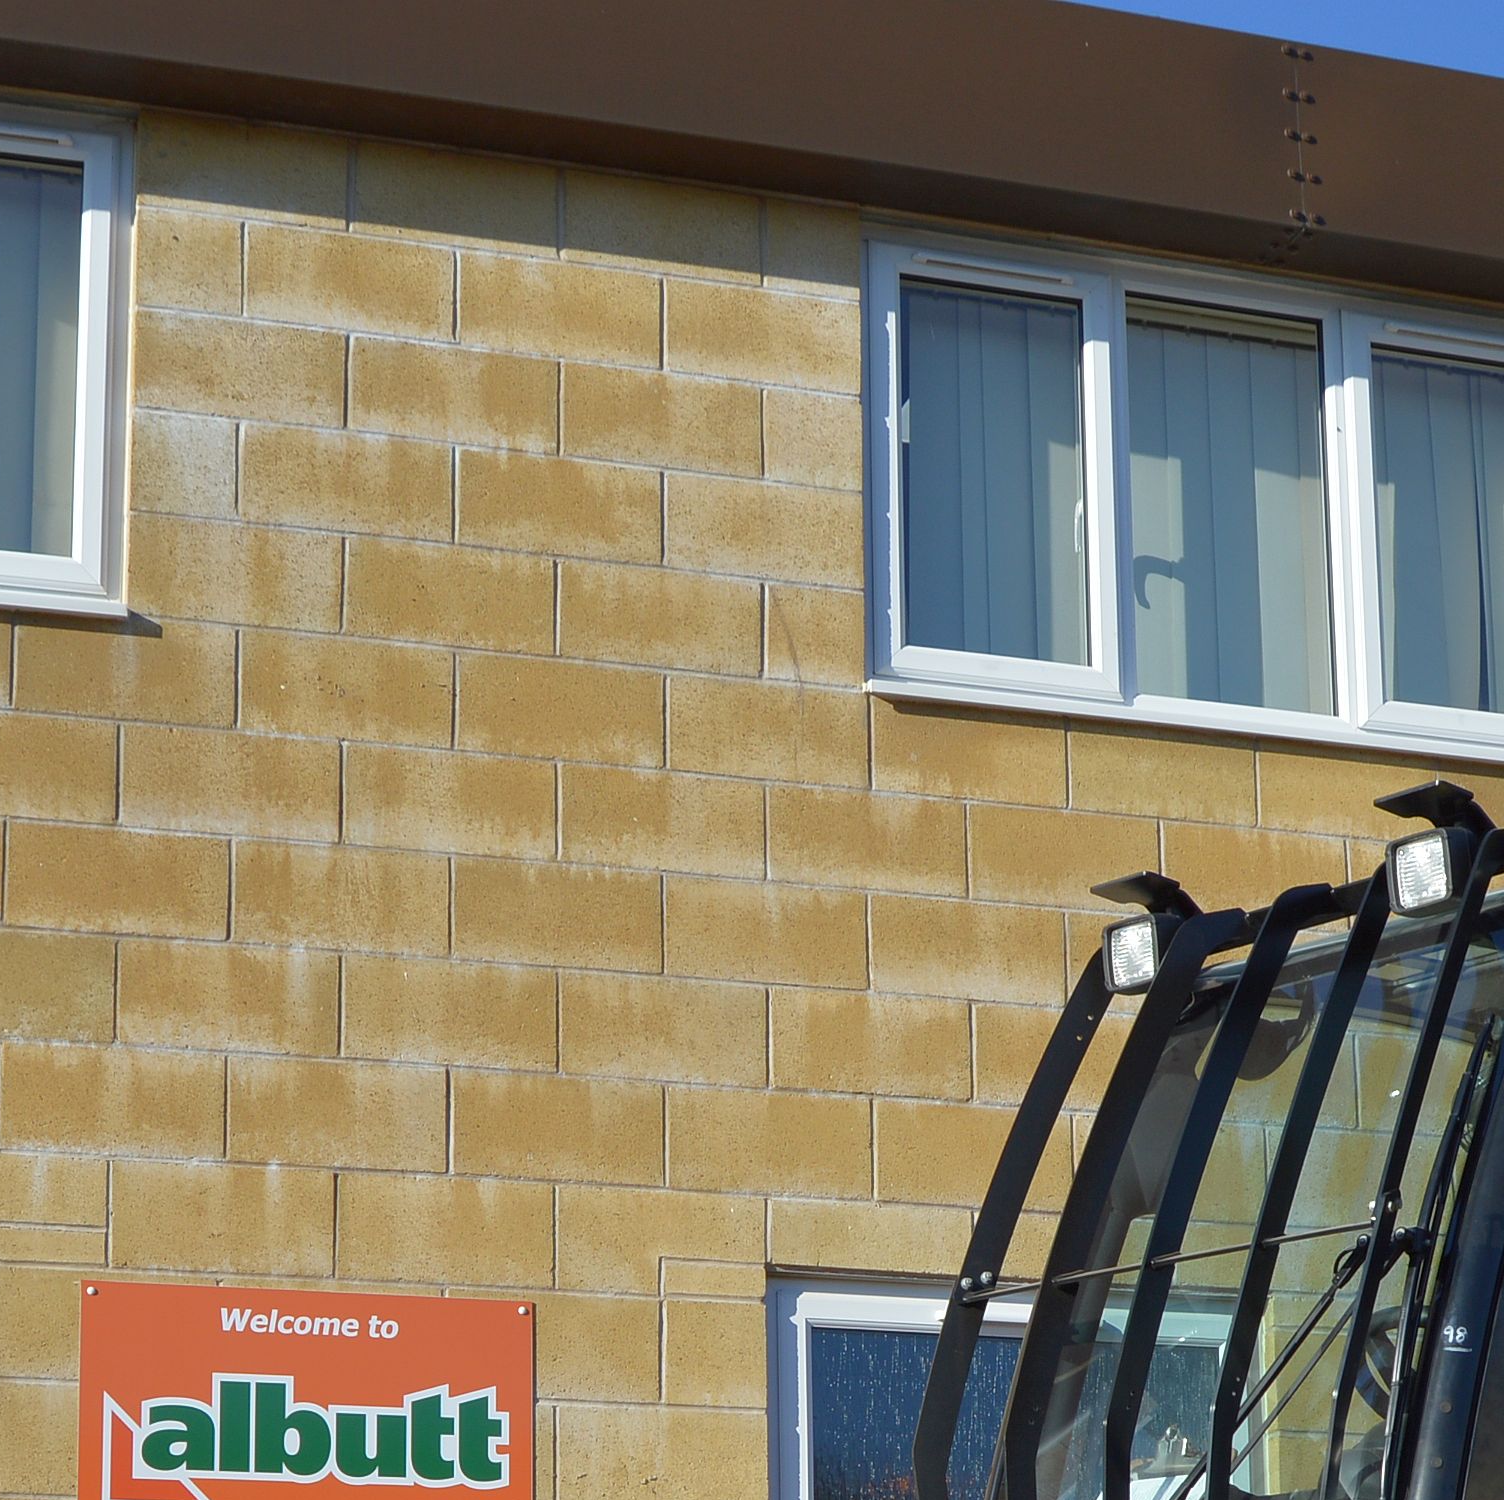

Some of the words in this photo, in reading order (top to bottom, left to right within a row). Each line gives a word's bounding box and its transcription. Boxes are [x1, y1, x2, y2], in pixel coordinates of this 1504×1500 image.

[219, 1306, 360, 1338] Welcome
[368, 1314, 400, 1339] to
[1442, 1324, 1468, 1344] 98
[136, 1374, 508, 1488] albutt
